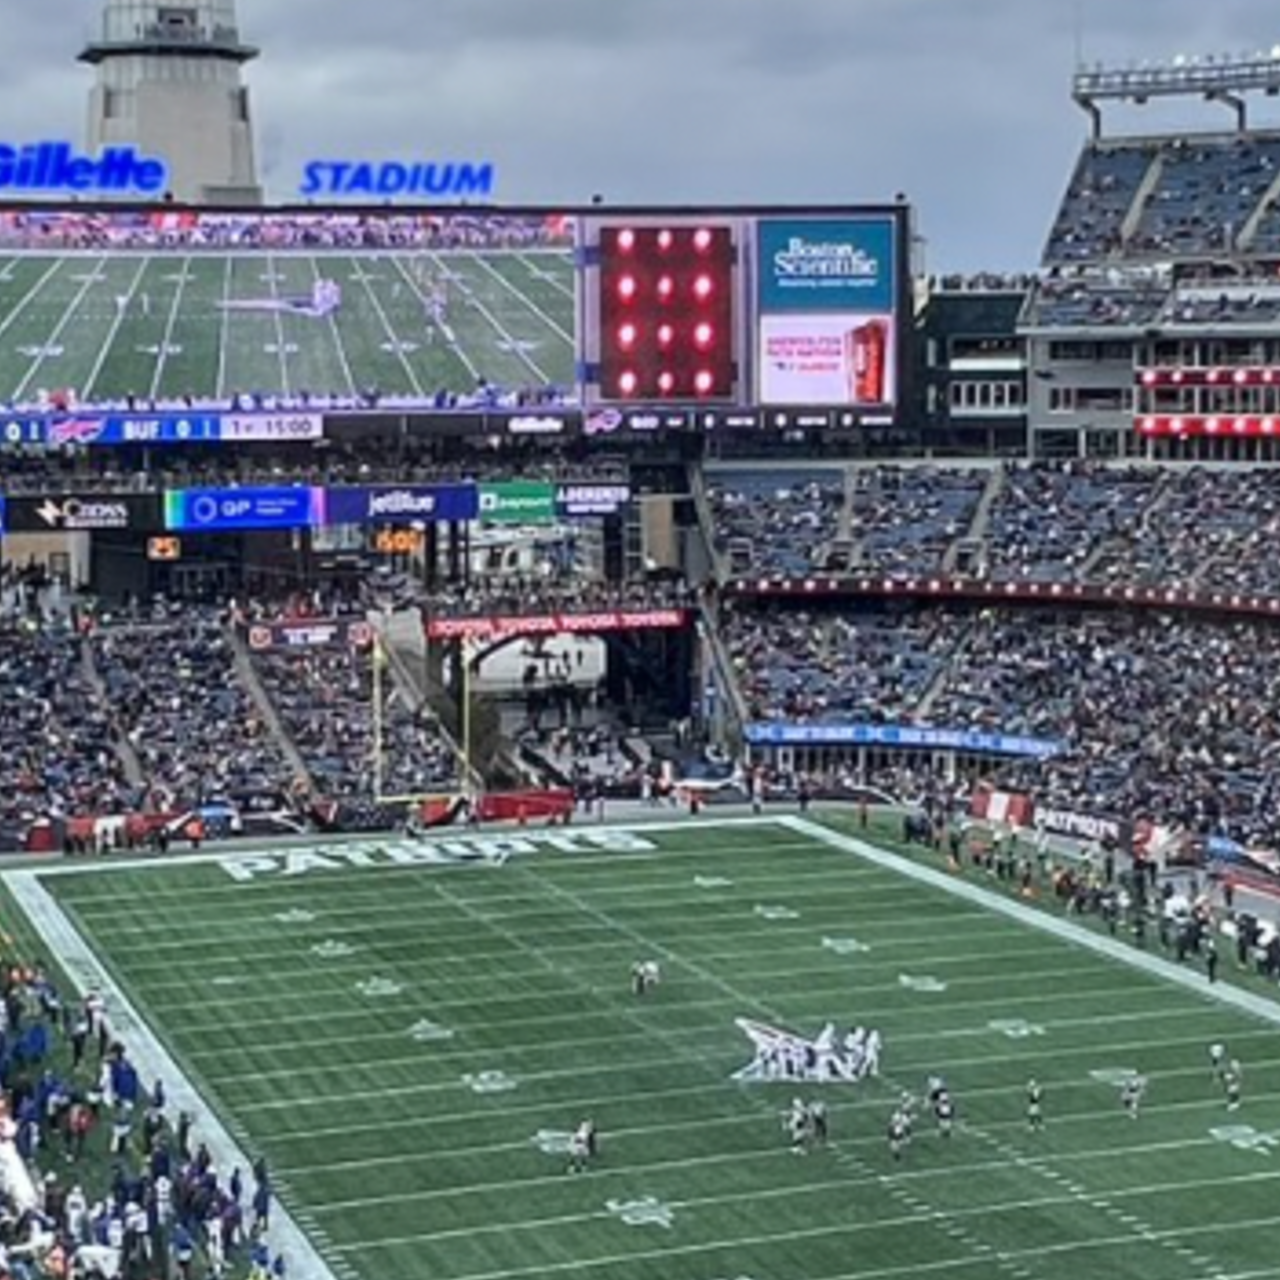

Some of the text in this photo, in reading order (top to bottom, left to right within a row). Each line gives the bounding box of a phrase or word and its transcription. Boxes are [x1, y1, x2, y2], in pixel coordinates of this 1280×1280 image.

[300, 161, 494, 195] STADIUM
[789, 237, 853, 256] Boston
[773, 250, 879, 276] Scientific
[123, 421, 159, 440] BUF
[265, 420, 312, 435] 15:00
[368, 491, 435, 517] jetBlue
[218, 828, 658, 882] PATRIOTS
